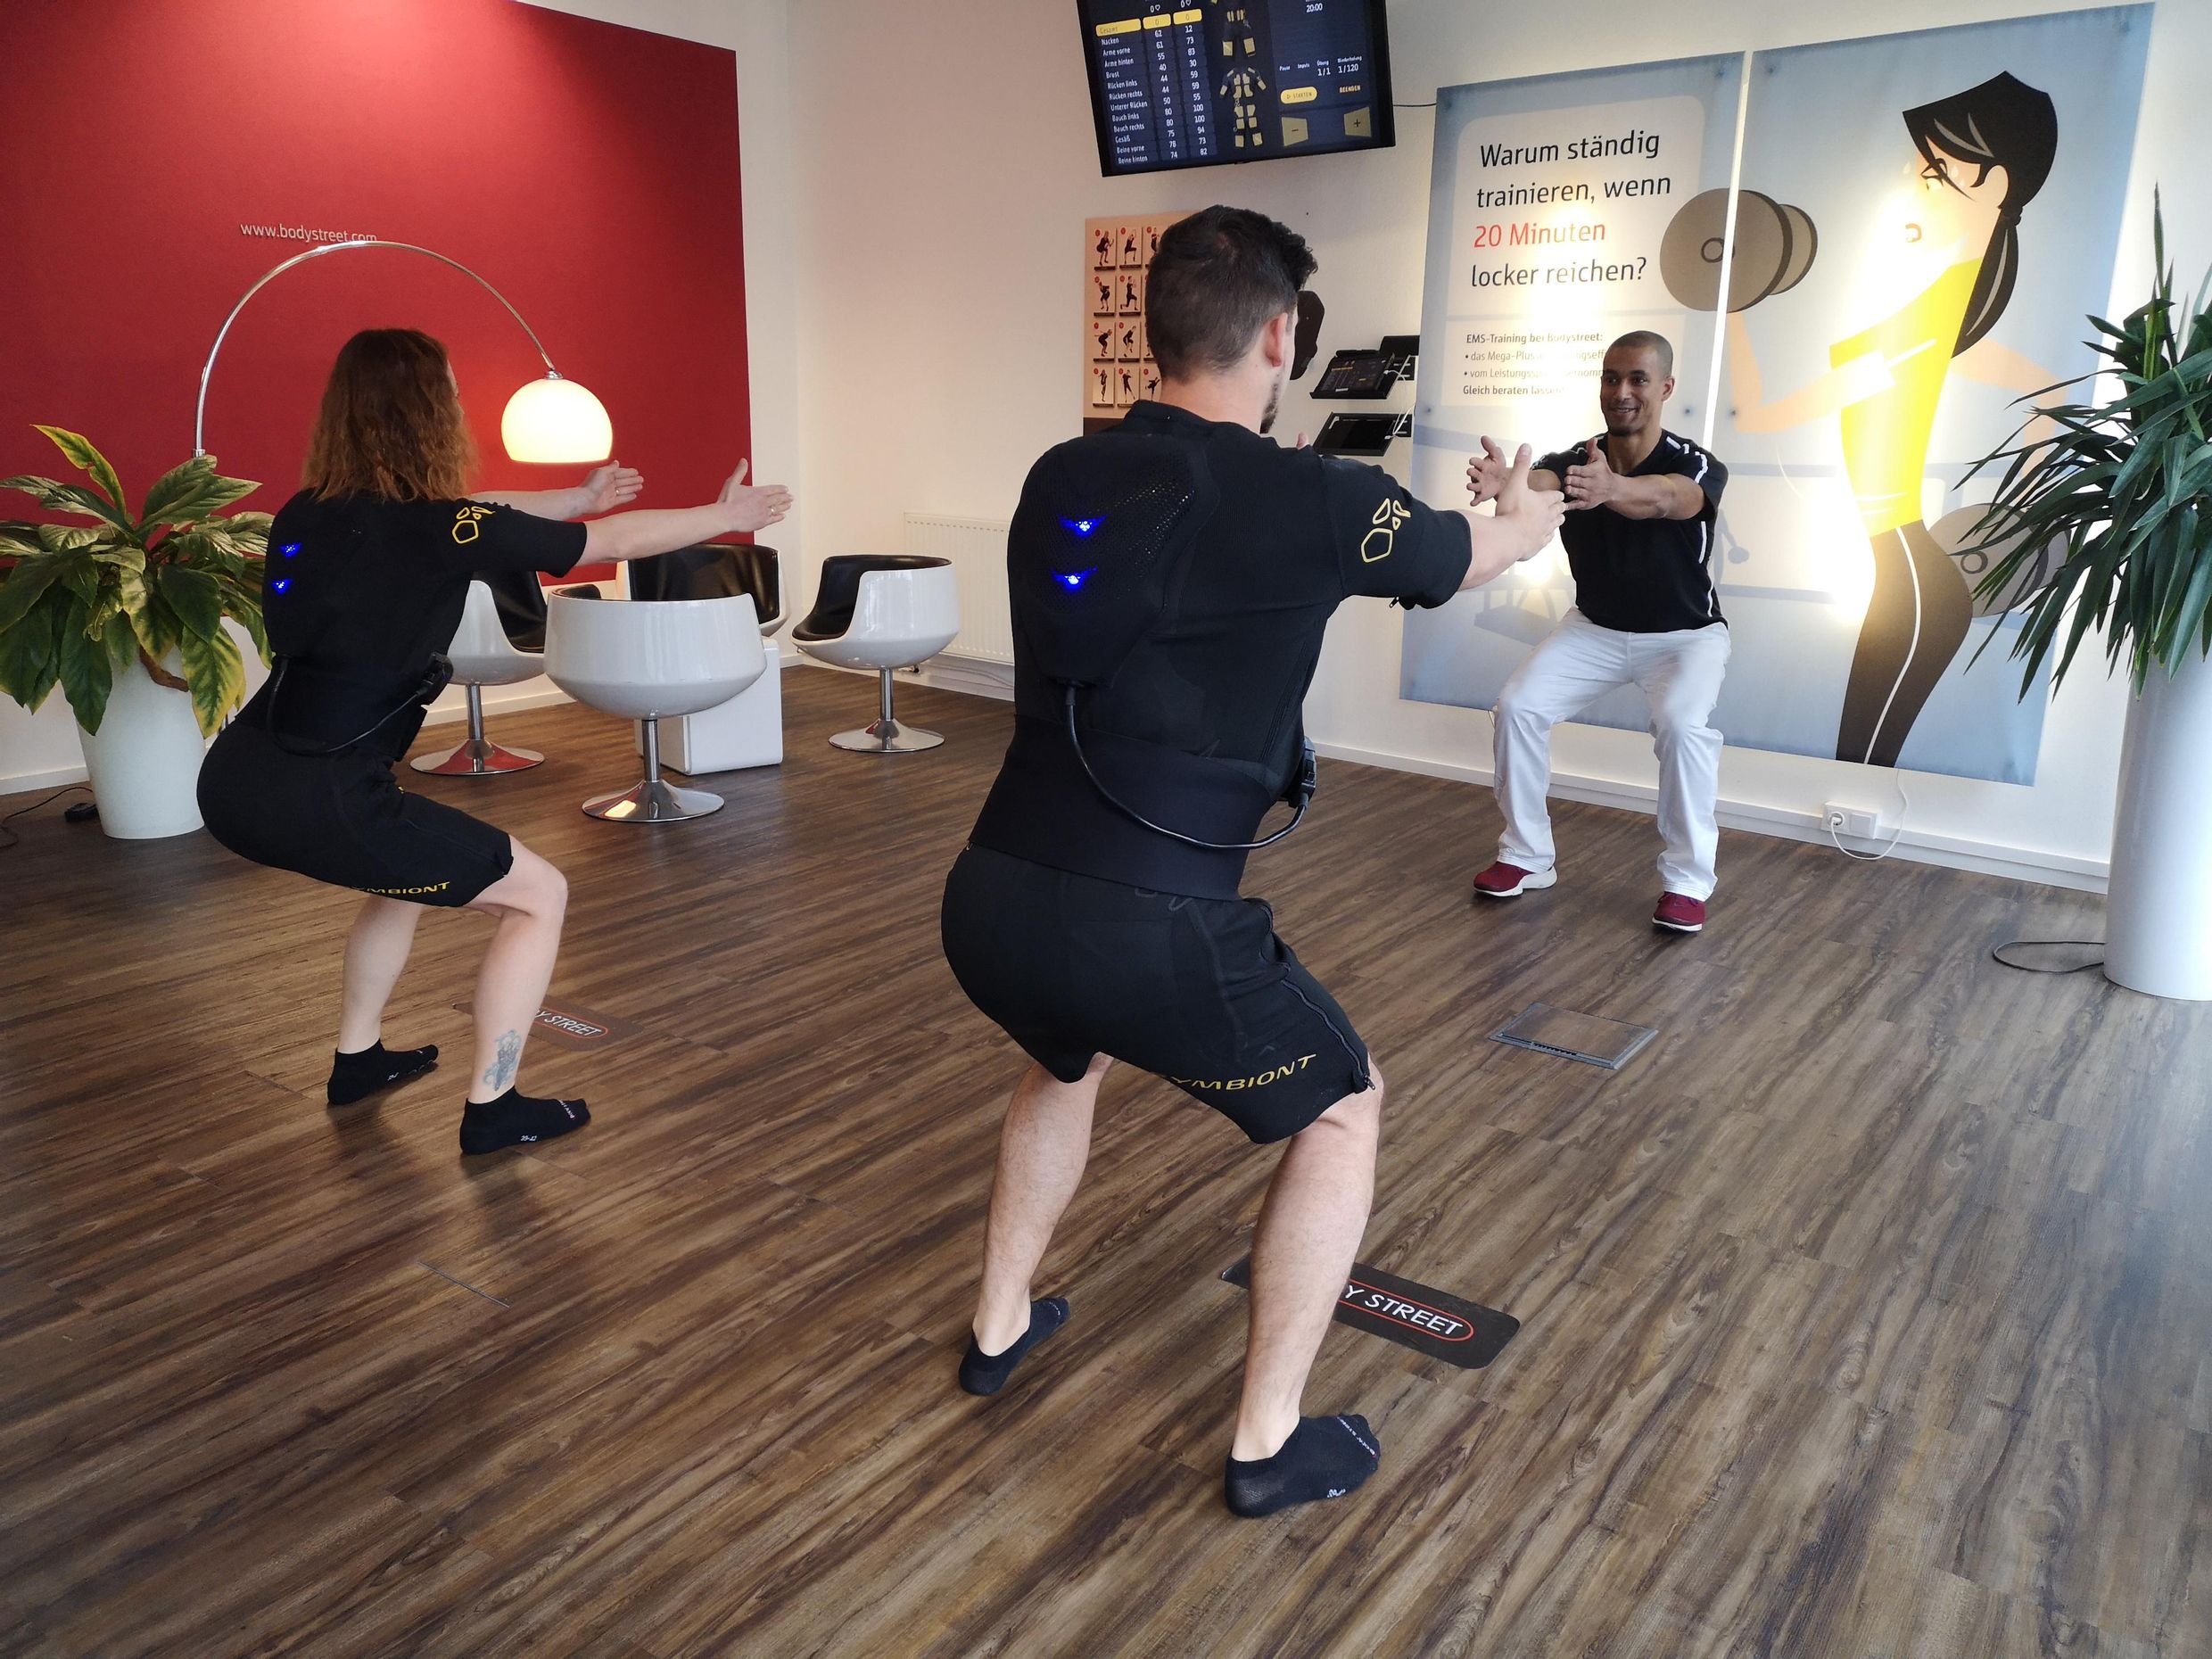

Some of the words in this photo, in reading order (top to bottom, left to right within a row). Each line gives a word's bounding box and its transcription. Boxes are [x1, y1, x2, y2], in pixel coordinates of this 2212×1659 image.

[1306, 3, 1324, 13] 20:00
[1101, 37, 1119, 45] Nacken
[1184, 25, 1193, 33] 12
[1104, 60, 1118, 68] Arme
[1118, 58, 1134, 66] hinten
[1157, 53, 1165, 61] 55
[1106, 70, 1119, 78] Brust
[1160, 63, 1167, 71] 40
[1189, 59, 1197, 67] 30
[1317, 67, 1331, 77] 1/1
[1338, 63, 1359, 74] 1/120
[1107, 81, 1125, 89] Rücken
[1125, 79, 1138, 87] links
[1160, 75, 1168, 83] 44
[1109, 91, 1127, 100] Rücken
[1127, 90, 1143, 99] rechts
[1161, 86, 1169, 94] 44
[1110, 103, 1129, 111] Unterer
[1129, 100, 1148, 109] Rücken
[1193, 93, 1201, 101] 55
[1112, 114, 1127, 122] Bauch
[1127, 112, 1140, 120] links
[1193, 103, 1204, 111] 100
[1113, 125, 1128, 133] Bauch
[1129, 123, 1144, 132] rechts
[1194, 115, 1205, 123] 100
[1168, 129, 1175, 137] 75
[1197, 126, 1205, 134] 94
[1117, 146, 1130, 154] Beine
[1131, 144, 1144, 153] vorne
[1199, 136, 1207, 144] 73
[1481, 143, 1559, 168] Warum
[1567, 129, 1660, 159] ständig
[1132, 154, 1148, 162] hinten
[1170, 152, 1178, 160] 74
[1200, 148, 1208, 156] 82
[1477, 182, 1595, 208] trainieren,
[1604, 177, 1671, 198] wenn
[240, 223, 377, 243] www.bodystreet.com
[1473, 224, 1502, 248] 20
[1509, 222, 1605, 246] Minuten
[1472, 263, 1539, 287] locker
[1546, 256, 1647, 284] reichen?
[1466, 333, 1527, 345] EMS-Training
[1530, 333, 1544, 343] bei
[1471, 351, 1486, 361] das
[1487, 351, 1535, 362] Mega-Plus
[1471, 370, 1488, 378] vom
[1464, 385, 1490, 395] Gleich
[1492, 385, 1528, 395] beraten
[544, 1015, 602, 1036] STREET
[1365, 1293, 1464, 1335] STREET
